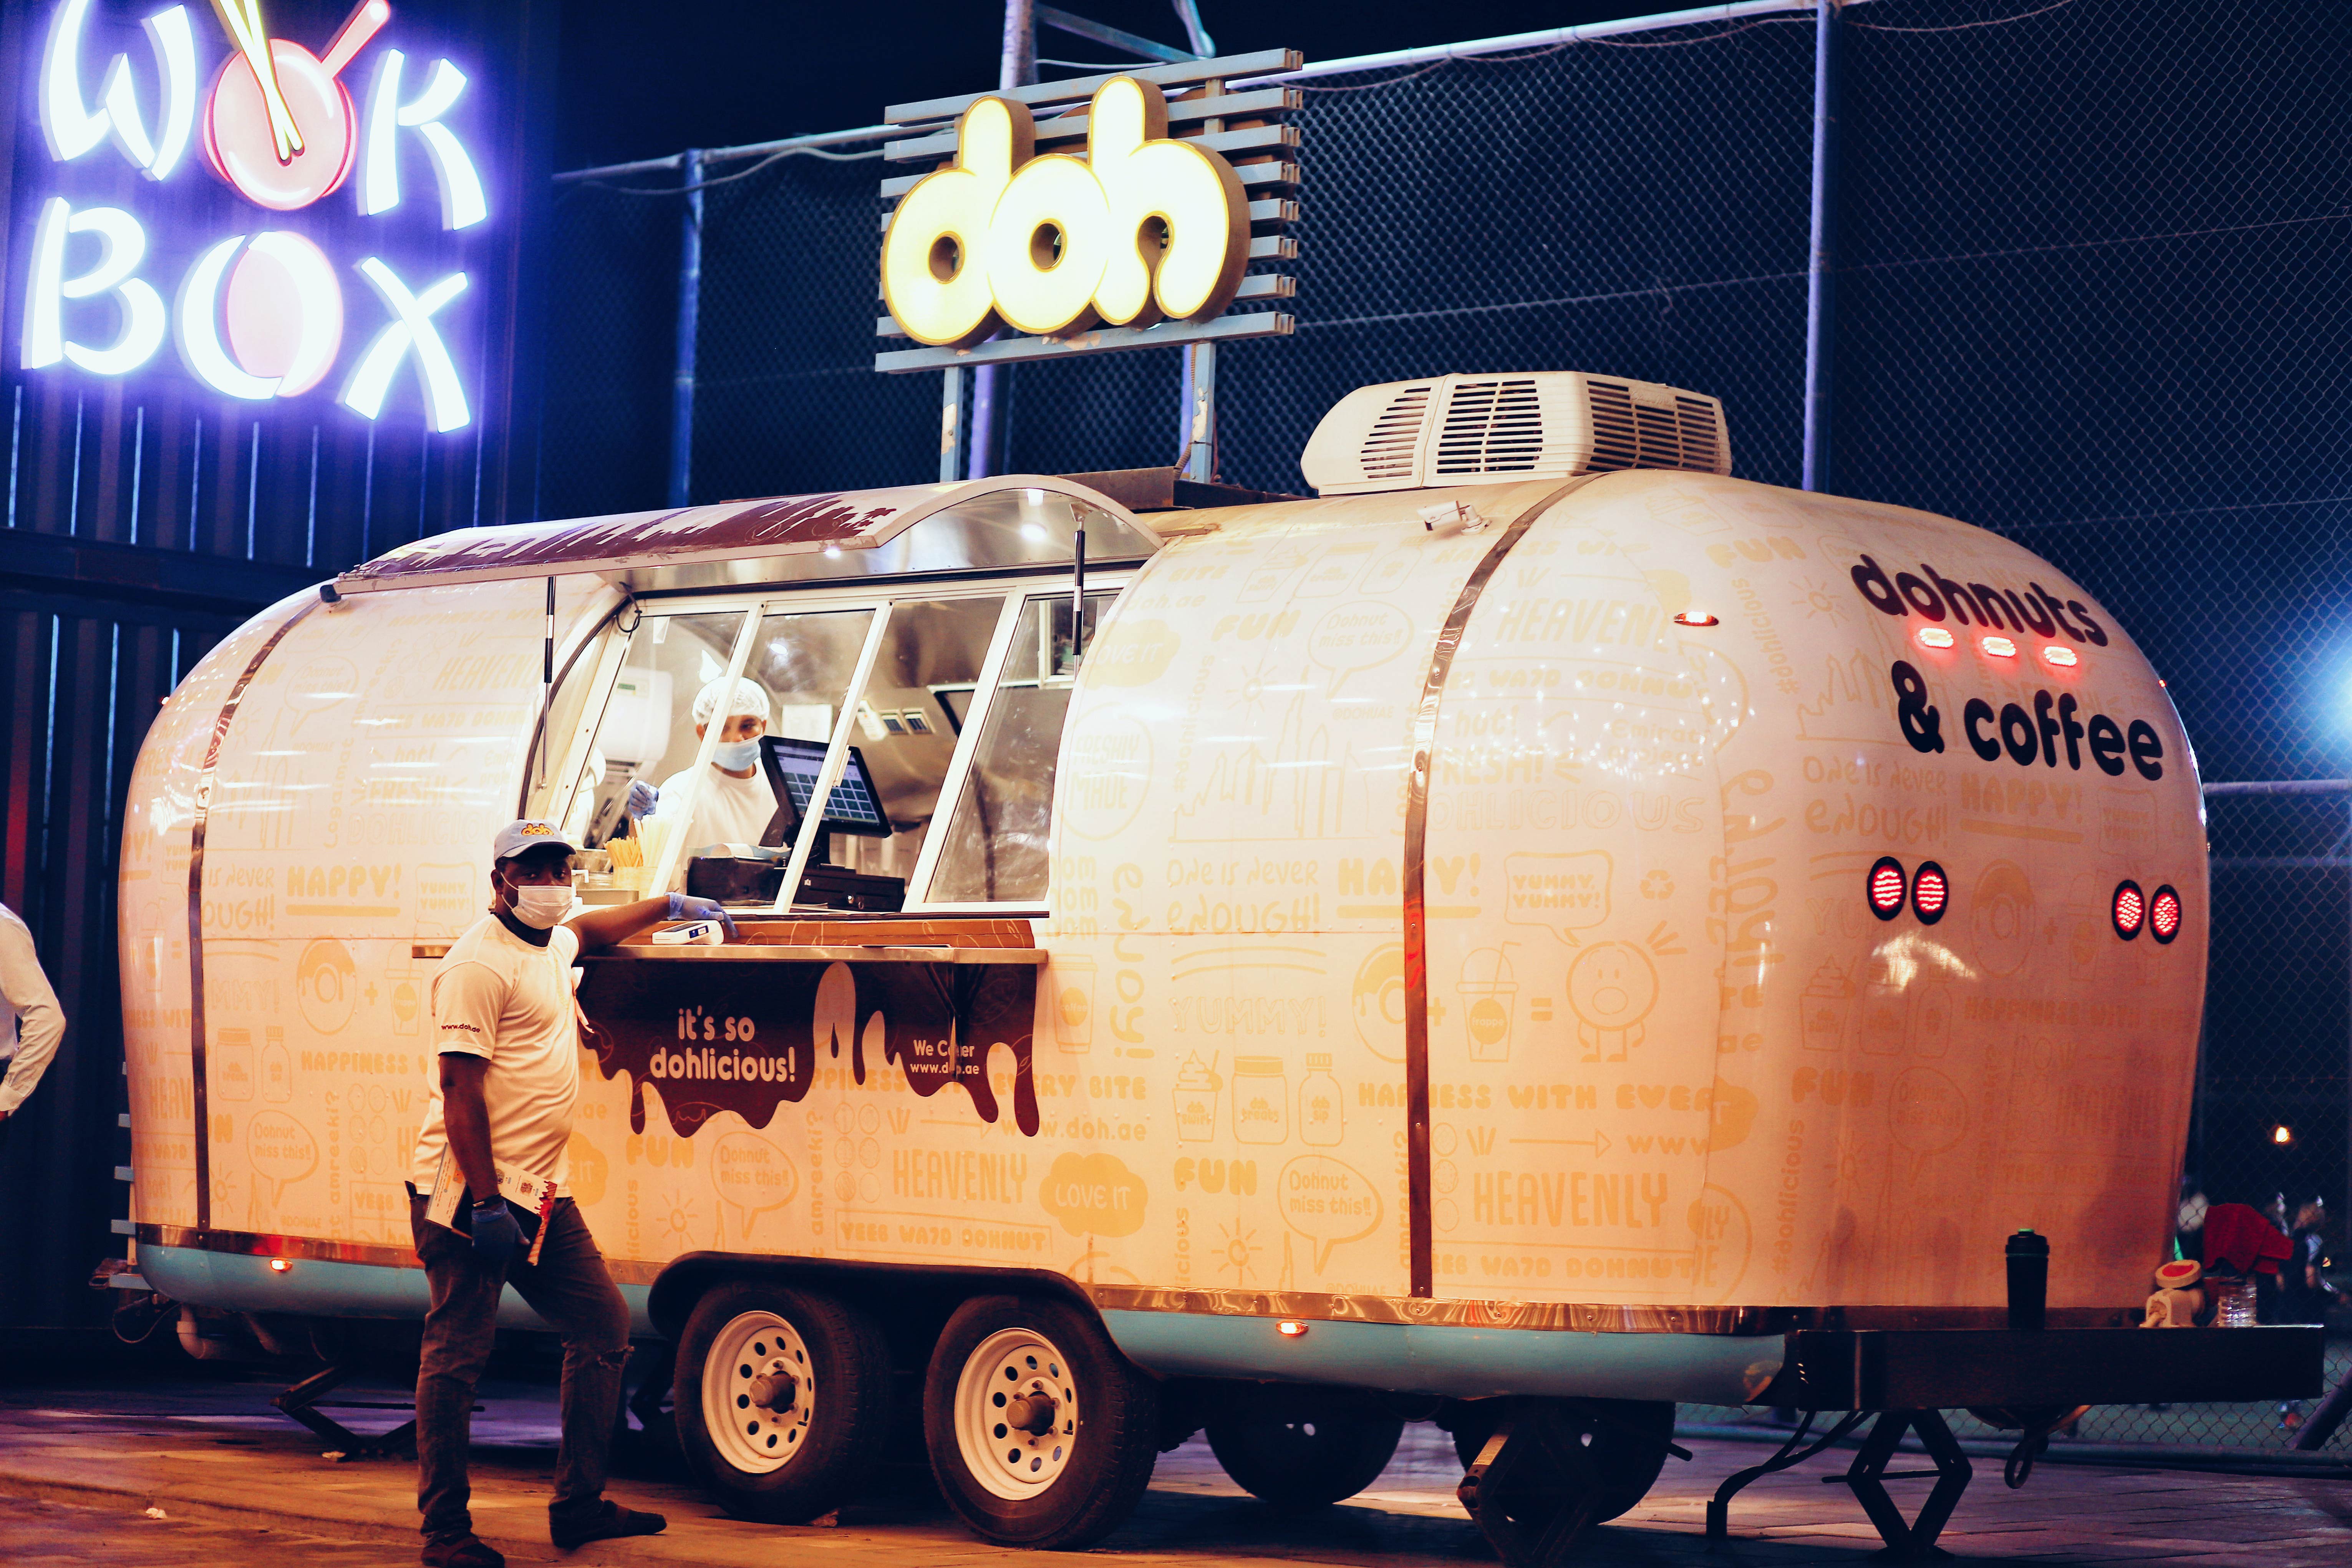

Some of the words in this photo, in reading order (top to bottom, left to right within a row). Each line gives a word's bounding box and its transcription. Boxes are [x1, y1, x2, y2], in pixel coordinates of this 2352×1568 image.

[880, 74, 1251, 348] doh
[20, 195, 471, 433] BOX
[1851, 552, 2109, 647] dohnuts
[1211, 609, 1301, 642] FUN
[1326, 612, 1387, 629] Dohnut
[1318, 632, 1354, 648] miss
[1891, 660, 1946, 754] &
[1964, 689, 2164, 781] coffee
[1428, 788, 1706, 833] OHLICIOUS
[521, 823, 554, 835] doh
[287, 863, 402, 900] HAPPY!
[1338, 857, 1480, 897] HAY!
[202, 894, 275, 931] OUGH!
[1513, 892, 1601, 908] YUMMY!
[441, 1023, 481, 1033] www.doh.ae
[678, 1005, 715, 1040] it's
[725, 1016, 755, 1042] so
[1168, 996, 1327, 1038] YUMMY!
[1472, 1017, 1505, 1029] frappe
[301, 1050, 408, 1074] HAPPINESS
[649, 1046, 796, 1082] dohlicious!
[913, 1039, 934, 1056] We
[937, 1040, 975, 1057] Cer
[1089, 1076, 1147, 1100] BITE
[1507, 1084, 1597, 1110] WITH
[1791, 1066, 1875, 1108] FUN
[625, 1134, 694, 1169] FUN
[719, 1144, 772, 1164] Dohnut
[721, 1169, 753, 1185] miss
[893, 1149, 1027, 1204] HEAVENLY
[1174, 1156, 1257, 1196] FUN
[1289, 1169, 1349, 1192] Dohnut
[1054, 1184, 1107, 1210] LOVE
[1111, 1184, 1132, 1211] IT
[1289, 1196, 1324, 1213] miss
[1474, 1170, 1668, 1228] HEAVENLY
[961, 1229, 1046, 1251] DOHNUT
